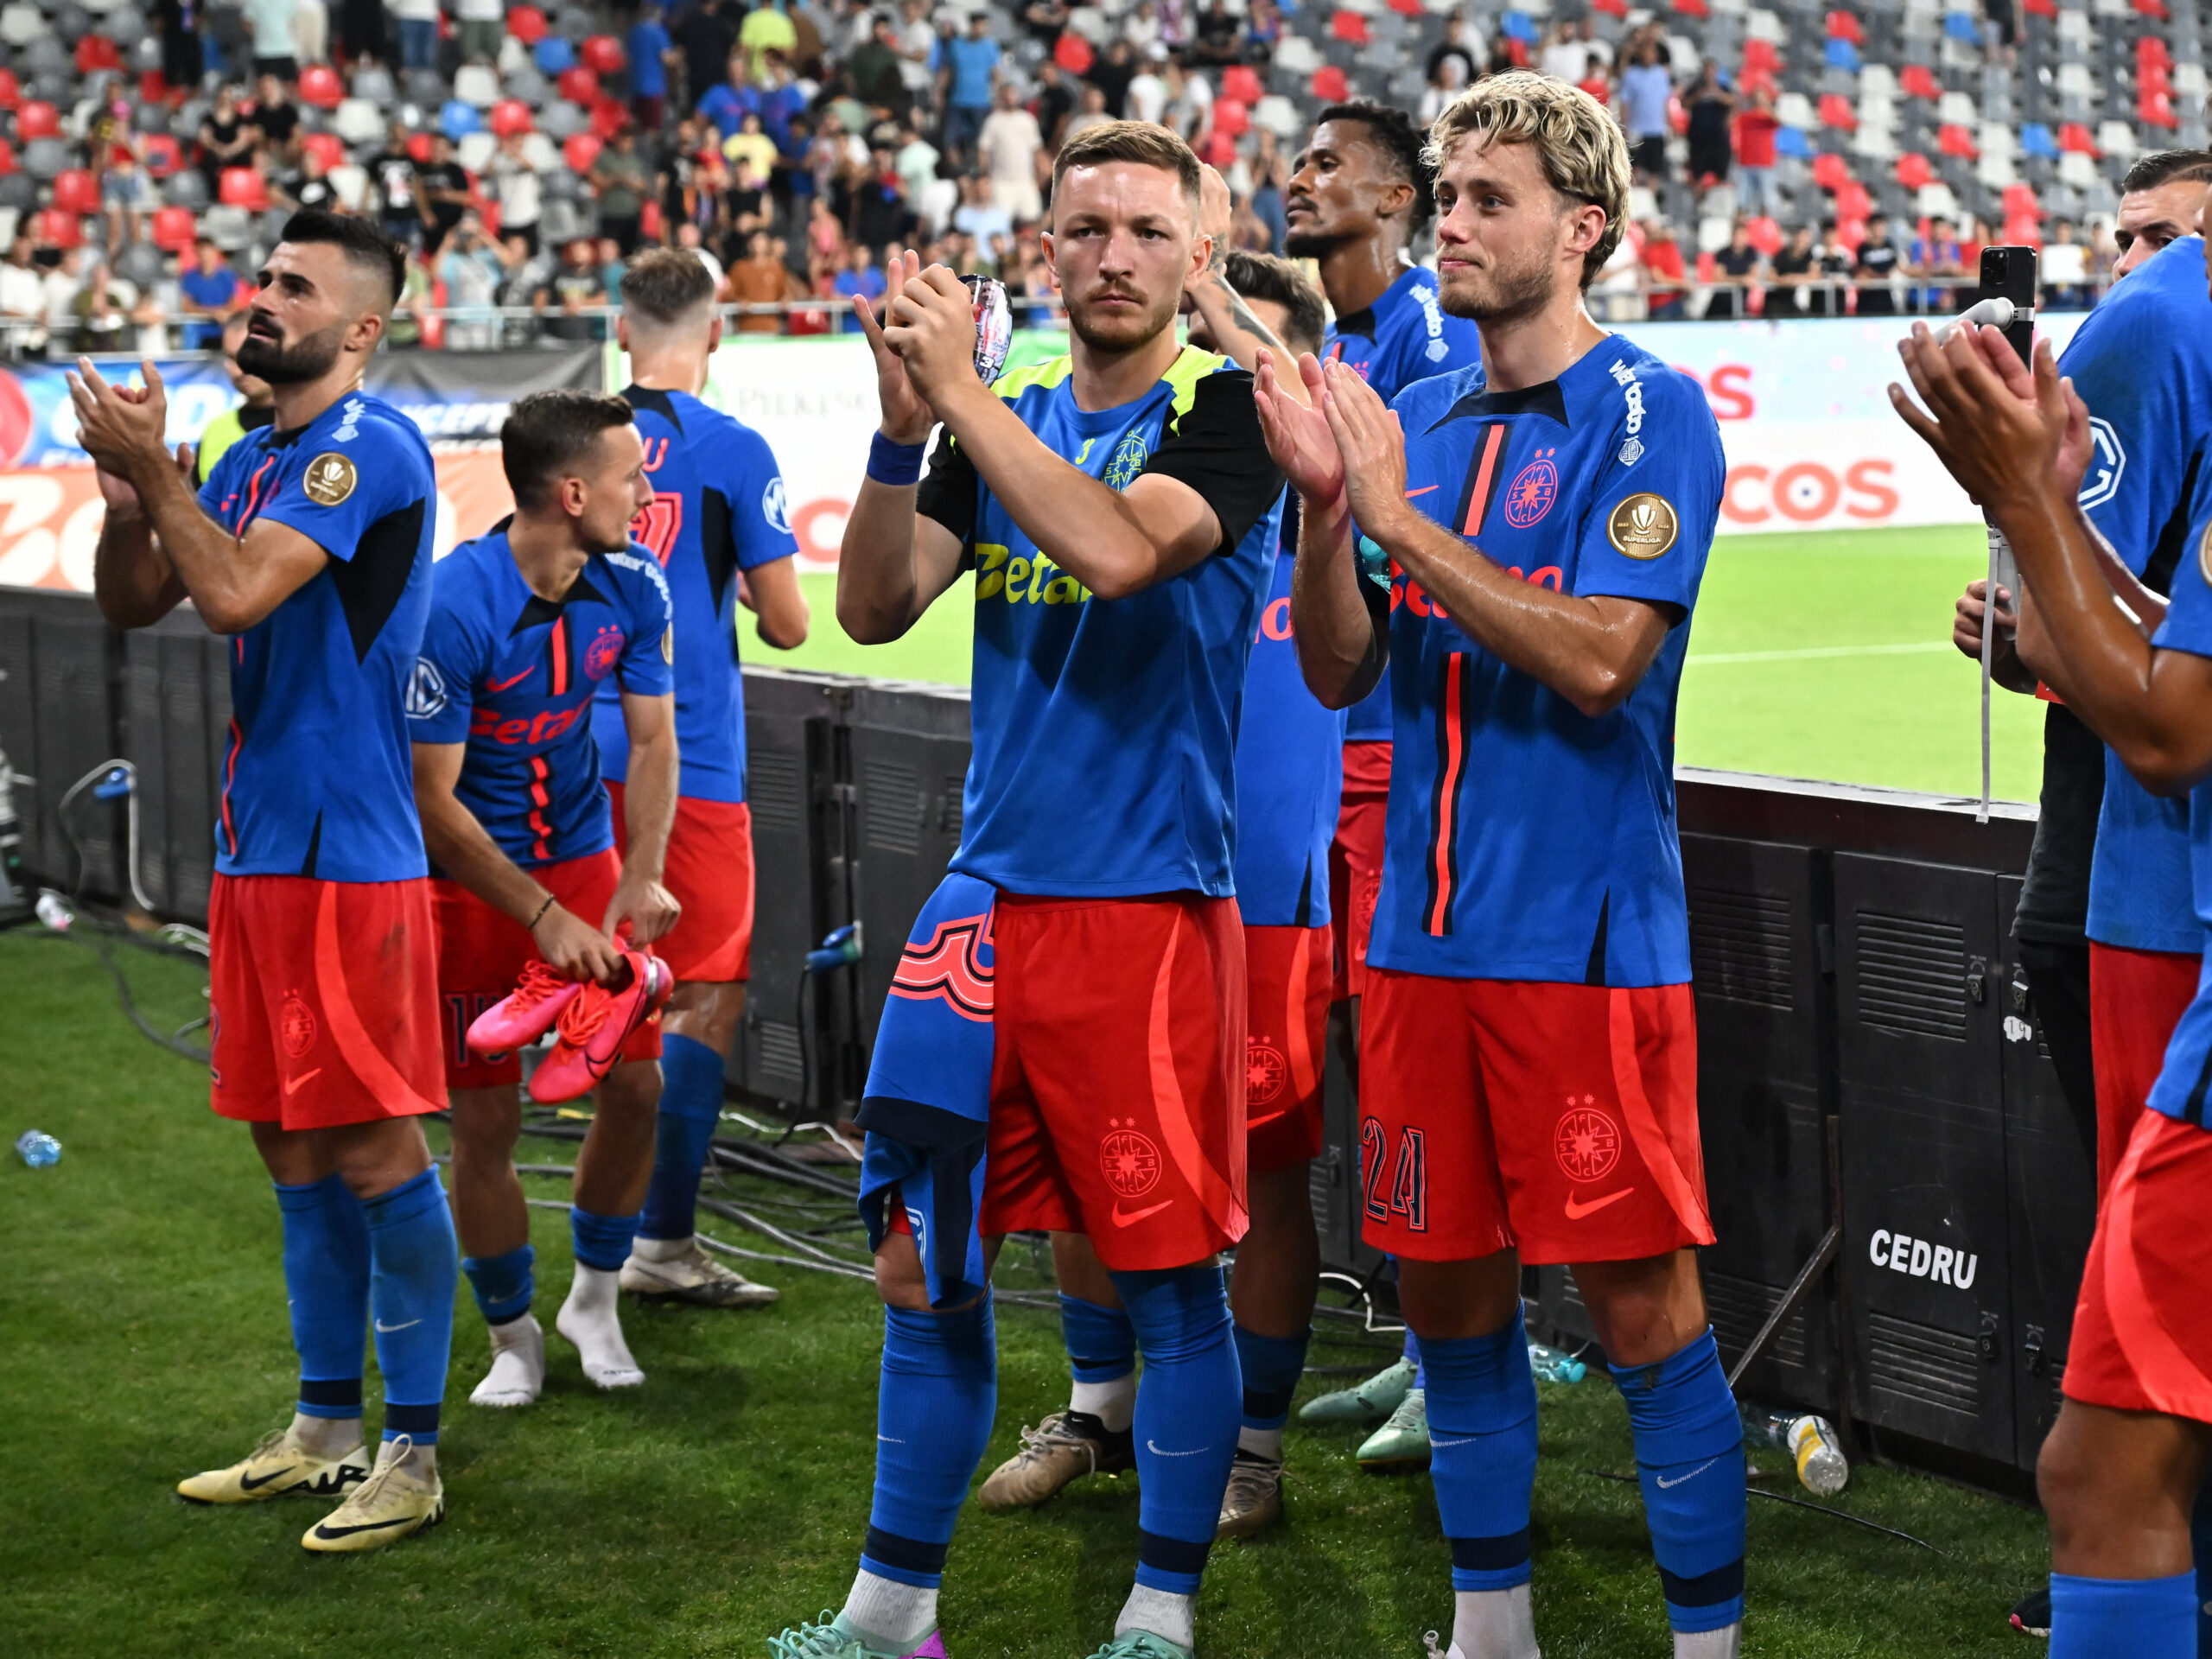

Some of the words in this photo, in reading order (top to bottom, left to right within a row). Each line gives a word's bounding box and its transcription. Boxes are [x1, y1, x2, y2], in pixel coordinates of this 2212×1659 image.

[1623, 535, 1662, 543] SUPERLIGA
[975, 542, 1093, 605] Beta
[469, 691, 594, 746] Beta
[1362, 1116, 1428, 1233] 24
[1869, 1229, 1978, 1290] CEDRU
